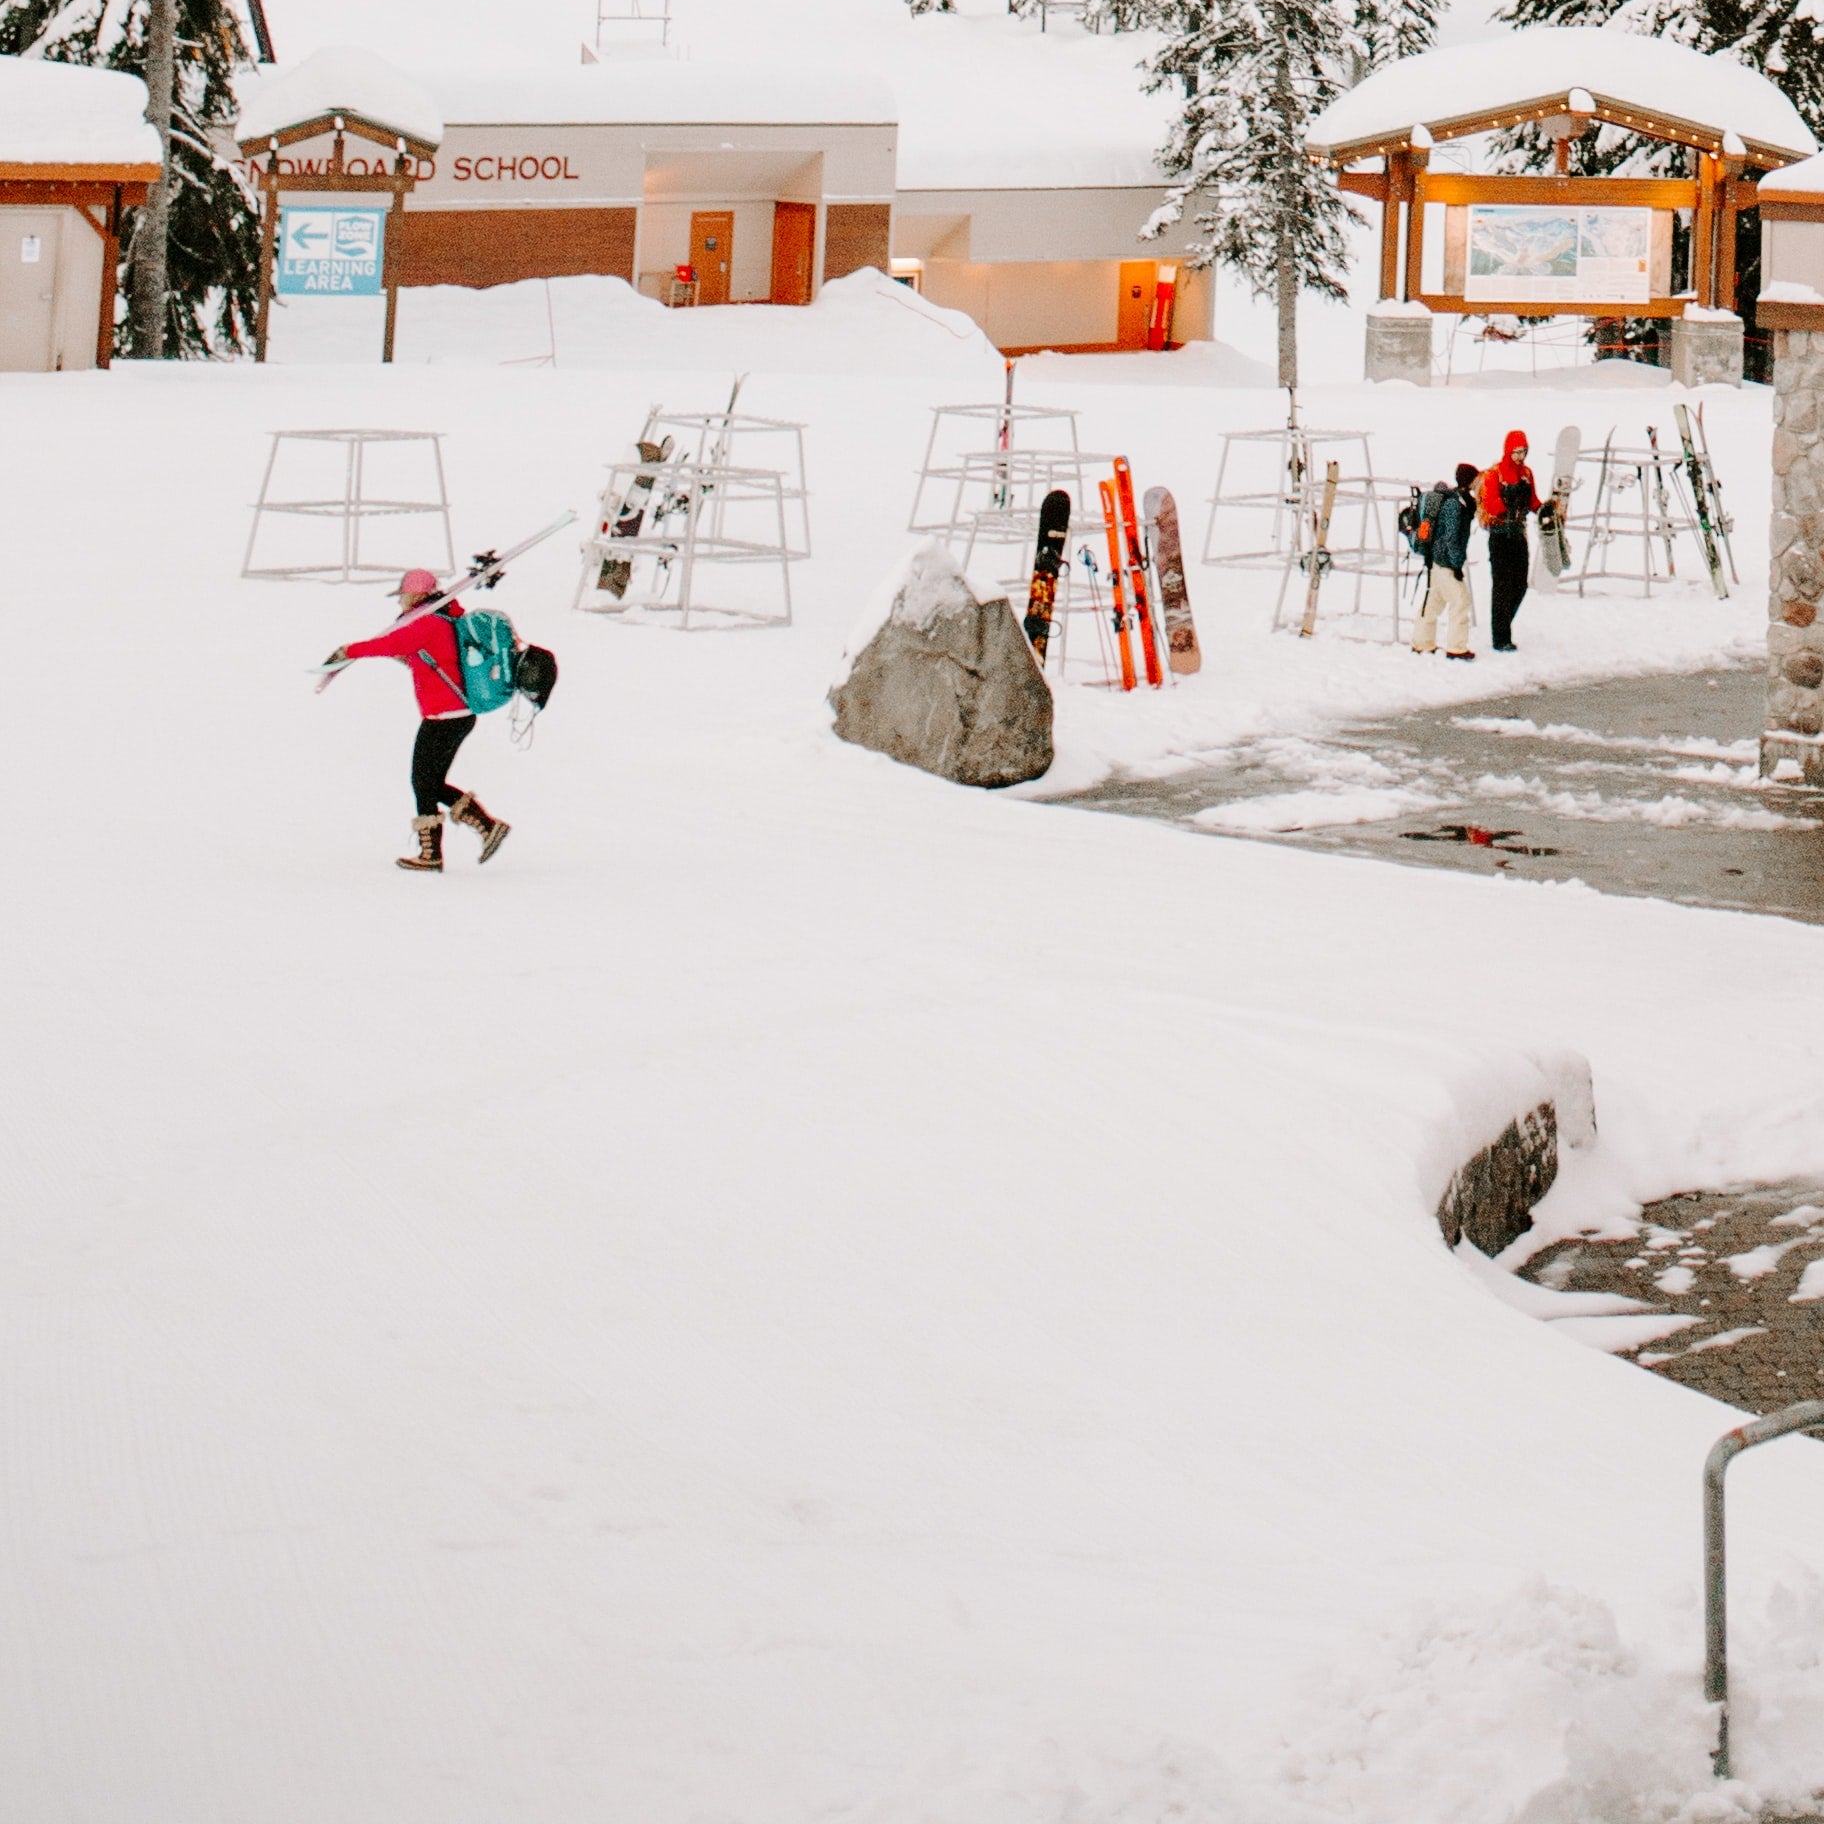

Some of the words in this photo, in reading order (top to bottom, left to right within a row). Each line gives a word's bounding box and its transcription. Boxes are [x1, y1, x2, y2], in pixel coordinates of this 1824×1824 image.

[453, 156, 580, 181] SCHOOL
[284, 260, 376, 276] LEARNING
[304, 275, 353, 290] AREA
